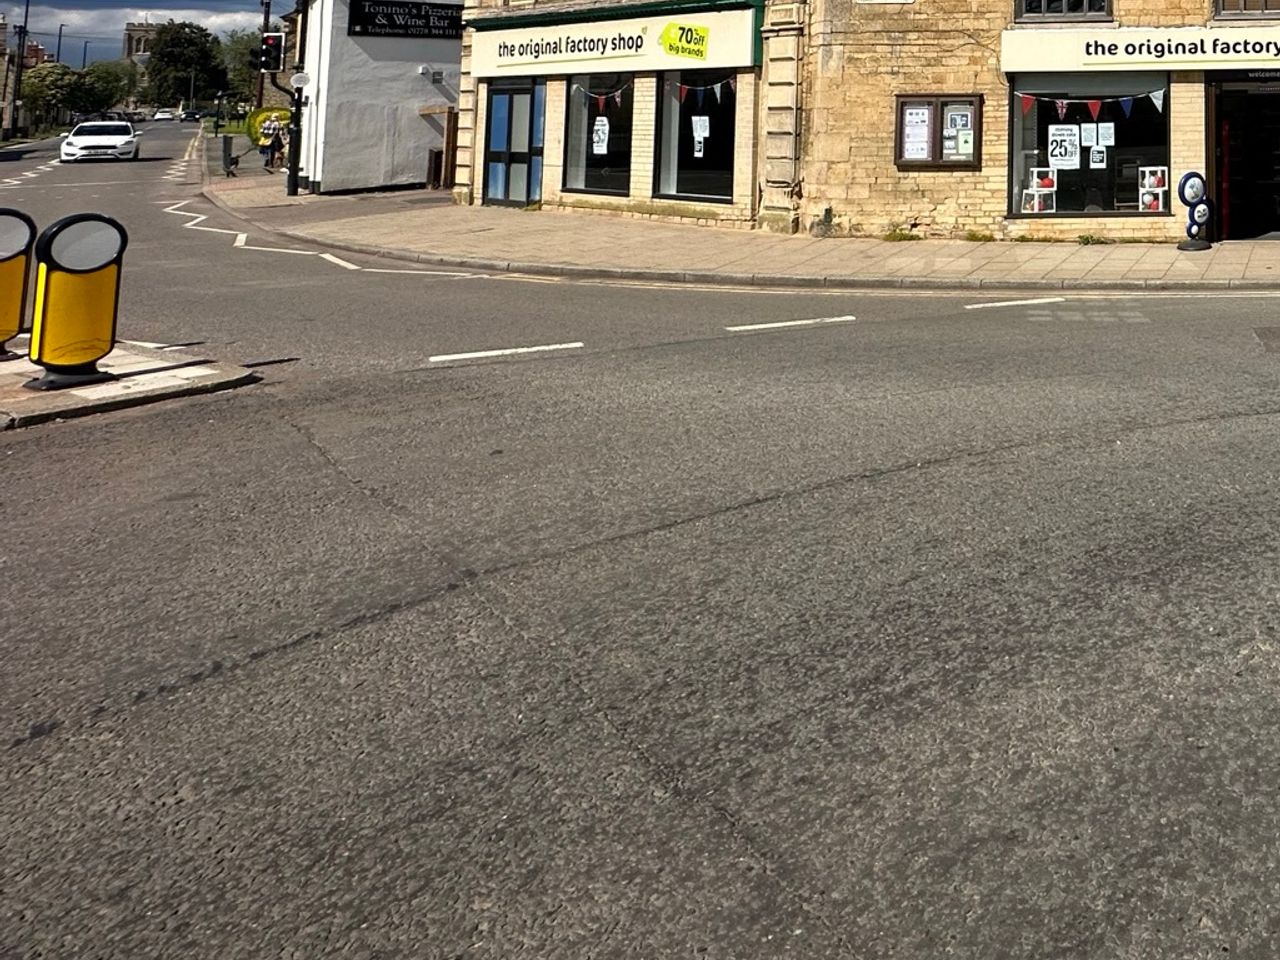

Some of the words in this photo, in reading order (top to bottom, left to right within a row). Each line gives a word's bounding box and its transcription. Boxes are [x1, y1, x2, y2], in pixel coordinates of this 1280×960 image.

[361, 1, 418, 15] Tonino's
[375, 14, 388, 25] &
[393, 13, 427, 27] Wine
[429, 16, 450, 27] Bar
[498, 41, 516, 57] the
[518, 37, 562, 59] original
[564, 35, 608, 55] factory
[611, 33, 644, 51] shop
[693, 35, 705, 46] off
[1085, 39, 1119, 56] the
[1124, 38, 1208, 58] original
[668, 42, 680, 55] big
[681, 44, 704, 58] brands
